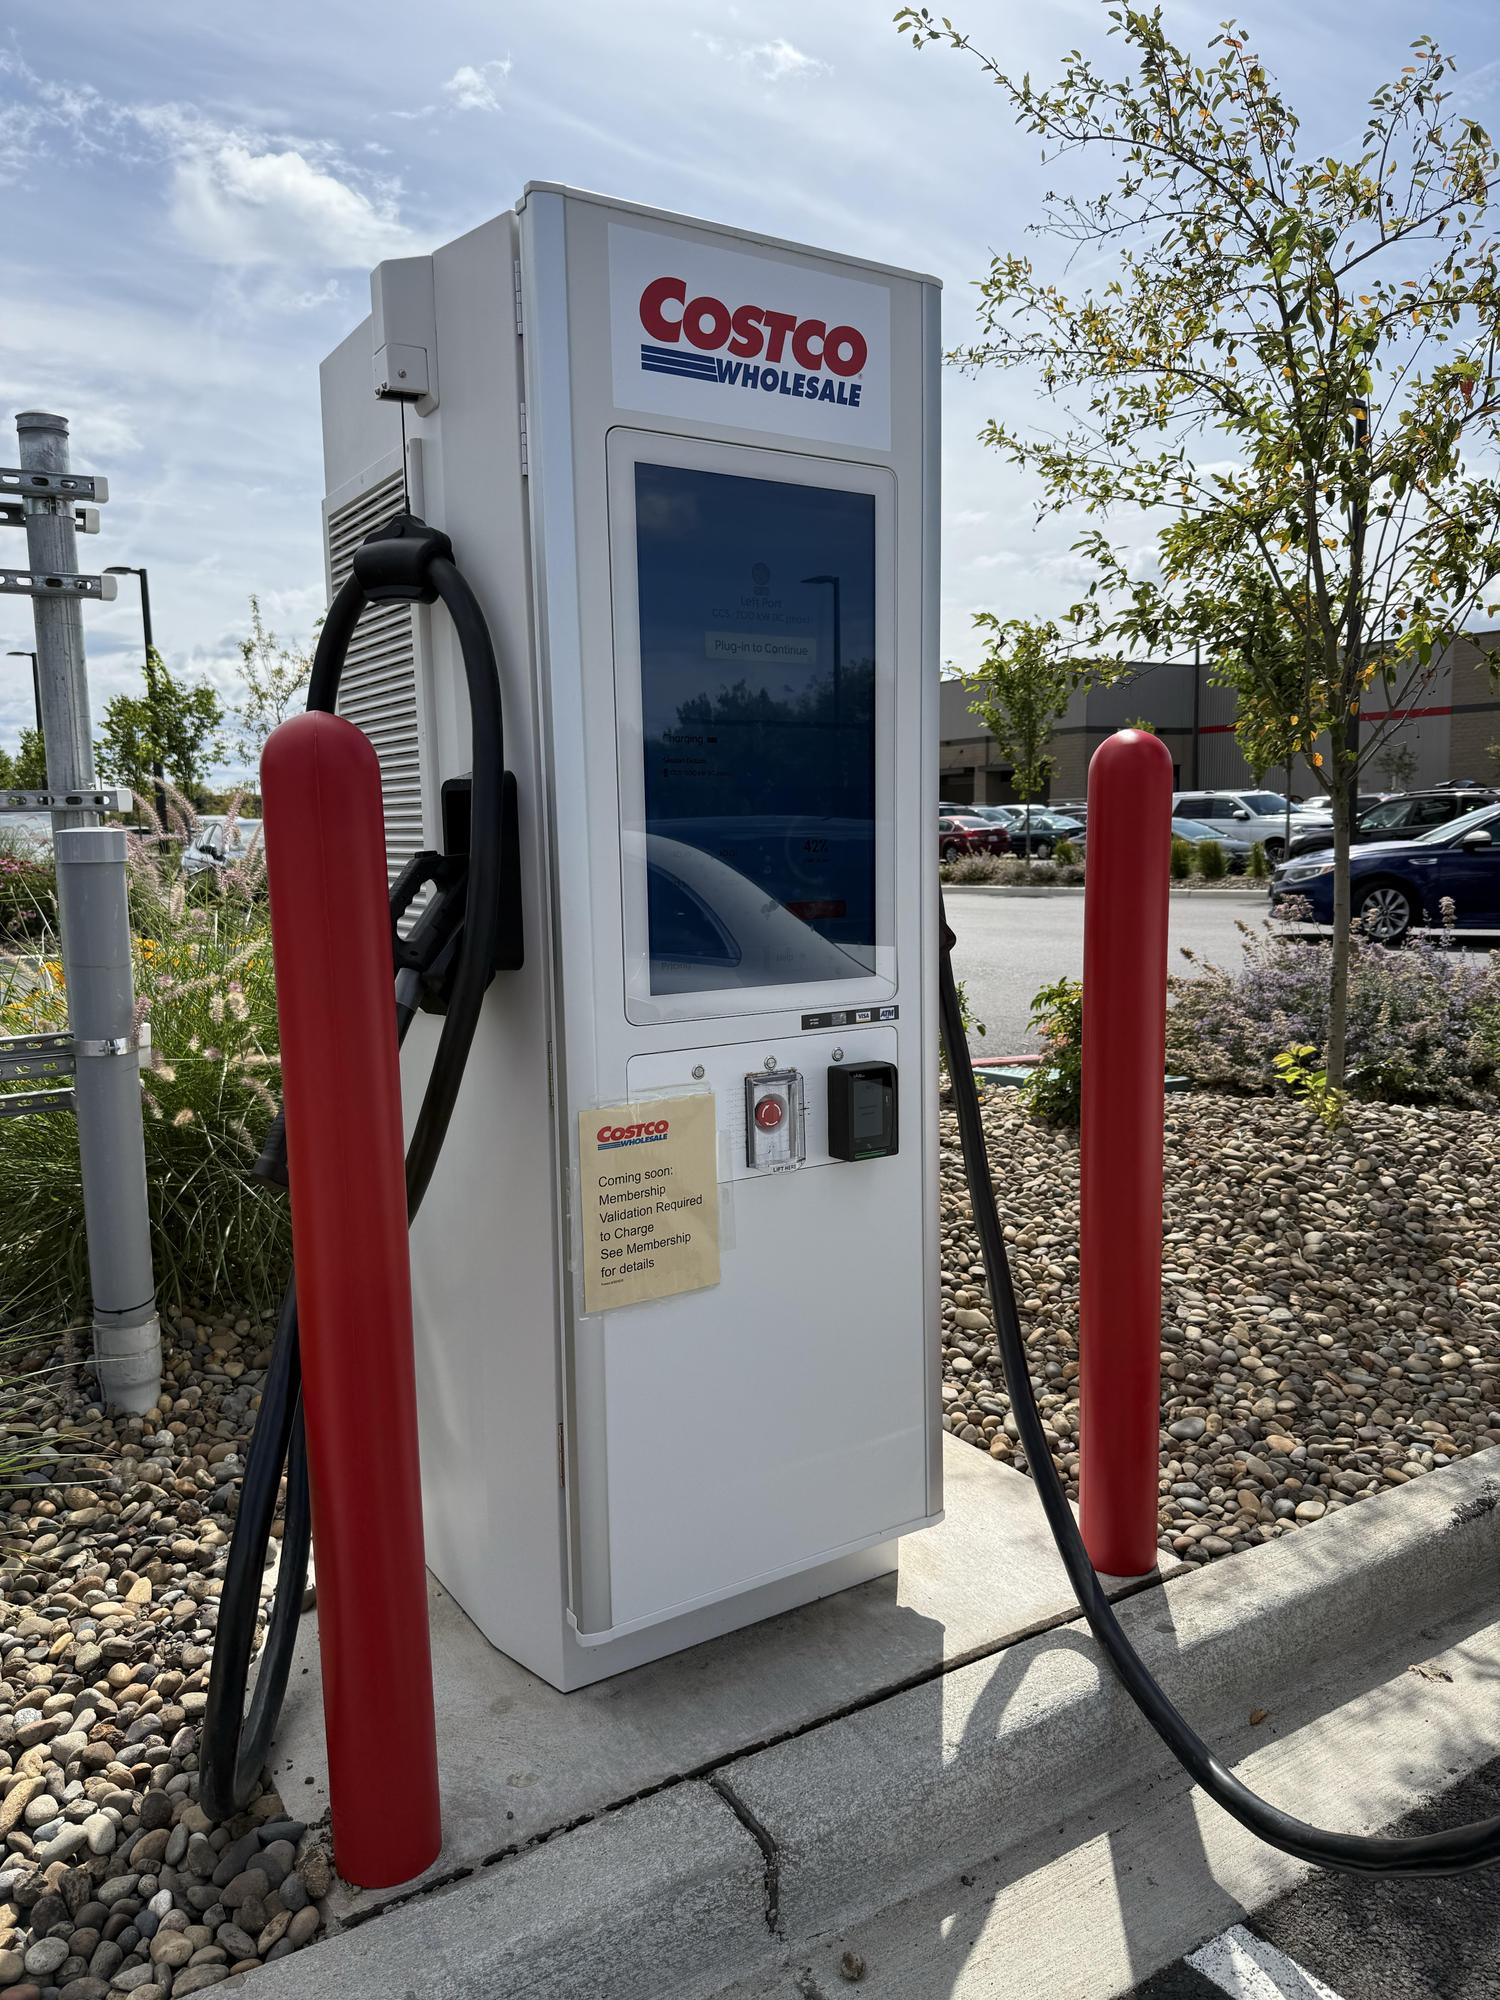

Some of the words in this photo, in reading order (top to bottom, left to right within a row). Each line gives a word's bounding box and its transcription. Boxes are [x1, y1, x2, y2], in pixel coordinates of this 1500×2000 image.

[639, 276, 868, 377] COSTCO
[715, 358, 862, 407] WHOLESALE
[752, 642, 763, 653] to
[765, 643, 809, 656] Continue
[597, 1120, 669, 1142] COSTCO
[620, 1133, 668, 1147] WHOLESALE
[598, 1173, 641, 1187] Coming
[644, 1167, 673, 1180] soon:
[599, 1184, 666, 1206] Membership
[599, 1206, 653, 1223] Validation
[656, 1194, 703, 1213] Required
[600, 1231, 611, 1242] to
[614, 1224, 654, 1239] Charge
[600, 1248, 623, 1260] See
[626, 1232, 691, 1255] Membership
[601, 1266, 616, 1278] for
[619, 1258, 655, 1274] details
